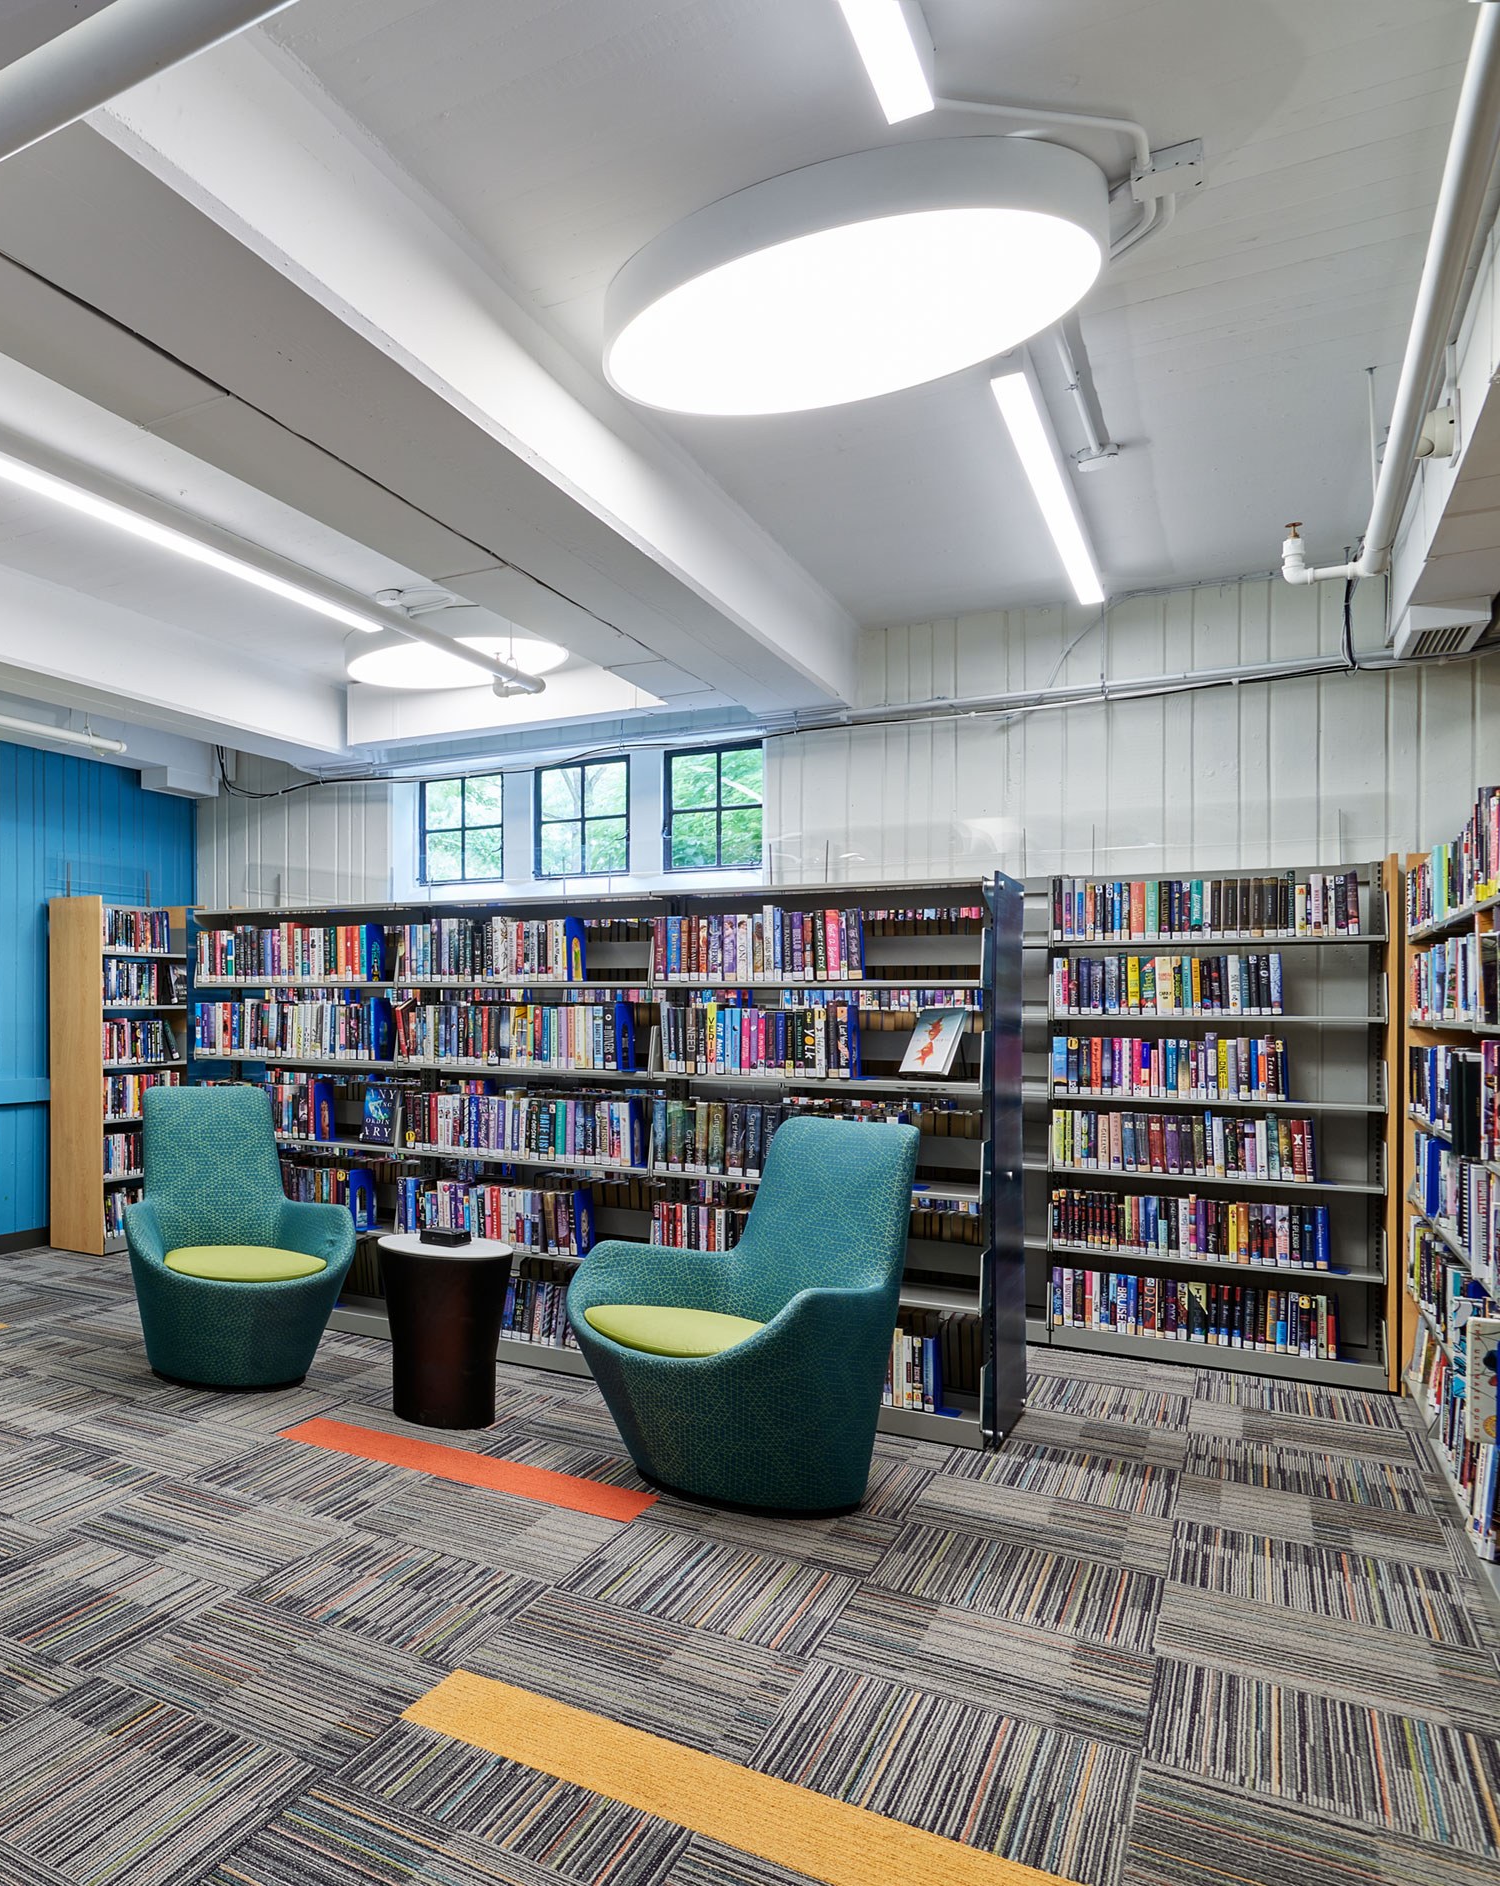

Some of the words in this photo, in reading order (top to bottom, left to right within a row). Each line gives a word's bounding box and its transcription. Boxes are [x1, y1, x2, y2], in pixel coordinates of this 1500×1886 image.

[793, 928, 802, 949] HELLO
[793, 951, 802, 971] GIRLS
[1260, 961, 1268, 984] GLOW
[687, 1027, 695, 1052] NEED
[1267, 1056, 1275, 1087] Trouble
[539, 1114, 550, 1133] HATE
[713, 1113, 721, 1127] City
[731, 1113, 739, 1124] City
[748, 1114, 756, 1125] City
[765, 1115, 775, 1133] Lady
[539, 1135, 550, 1152] LIST
[685, 1130, 693, 1143] City
[1293, 1134, 1303, 1145] X
[1478, 1180, 1486, 1214] MARVEL
[1117, 1287, 1126, 1324] BRUISER
[1145, 1286, 1155, 1313] DRY
